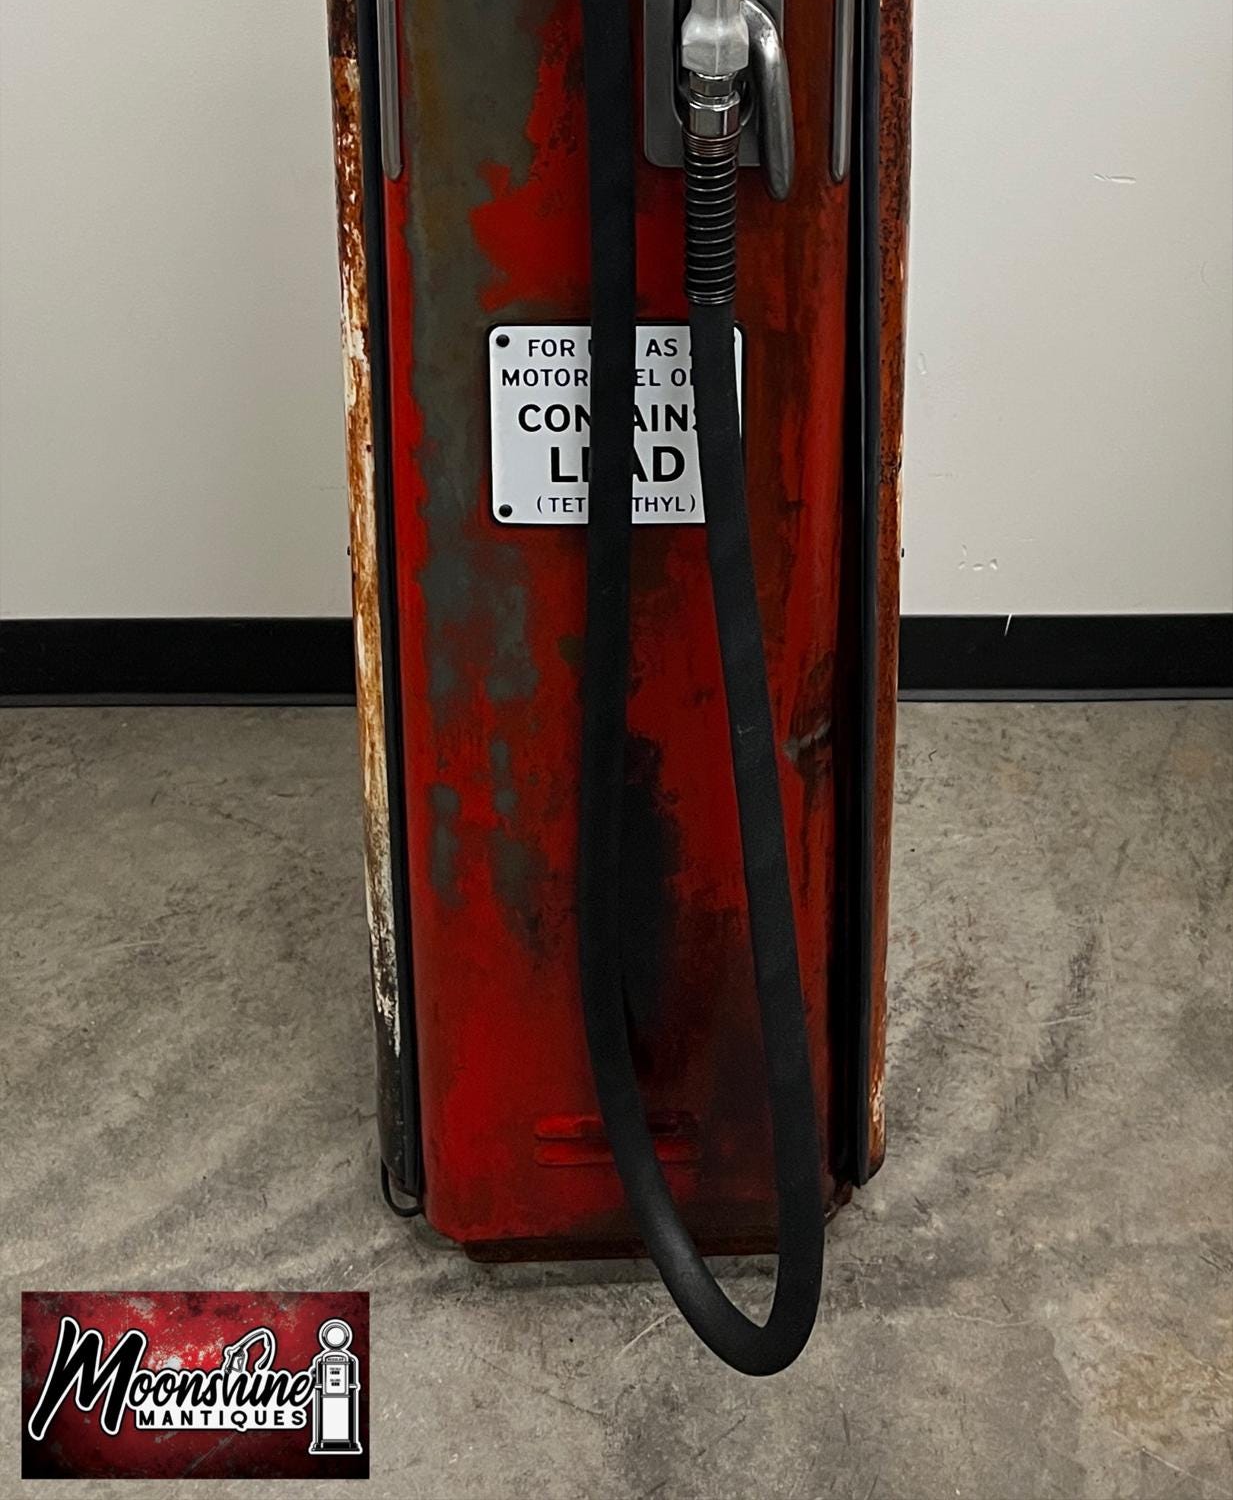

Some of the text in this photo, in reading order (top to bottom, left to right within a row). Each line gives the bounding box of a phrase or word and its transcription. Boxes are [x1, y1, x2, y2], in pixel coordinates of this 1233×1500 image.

[528, 339, 575, 357] FOR
[646, 338, 678, 357] AS
[502, 368, 588, 387] MOTOR
[518, 403, 697, 432] CONAIN
[536, 496, 696, 513] (TETTHYL)
